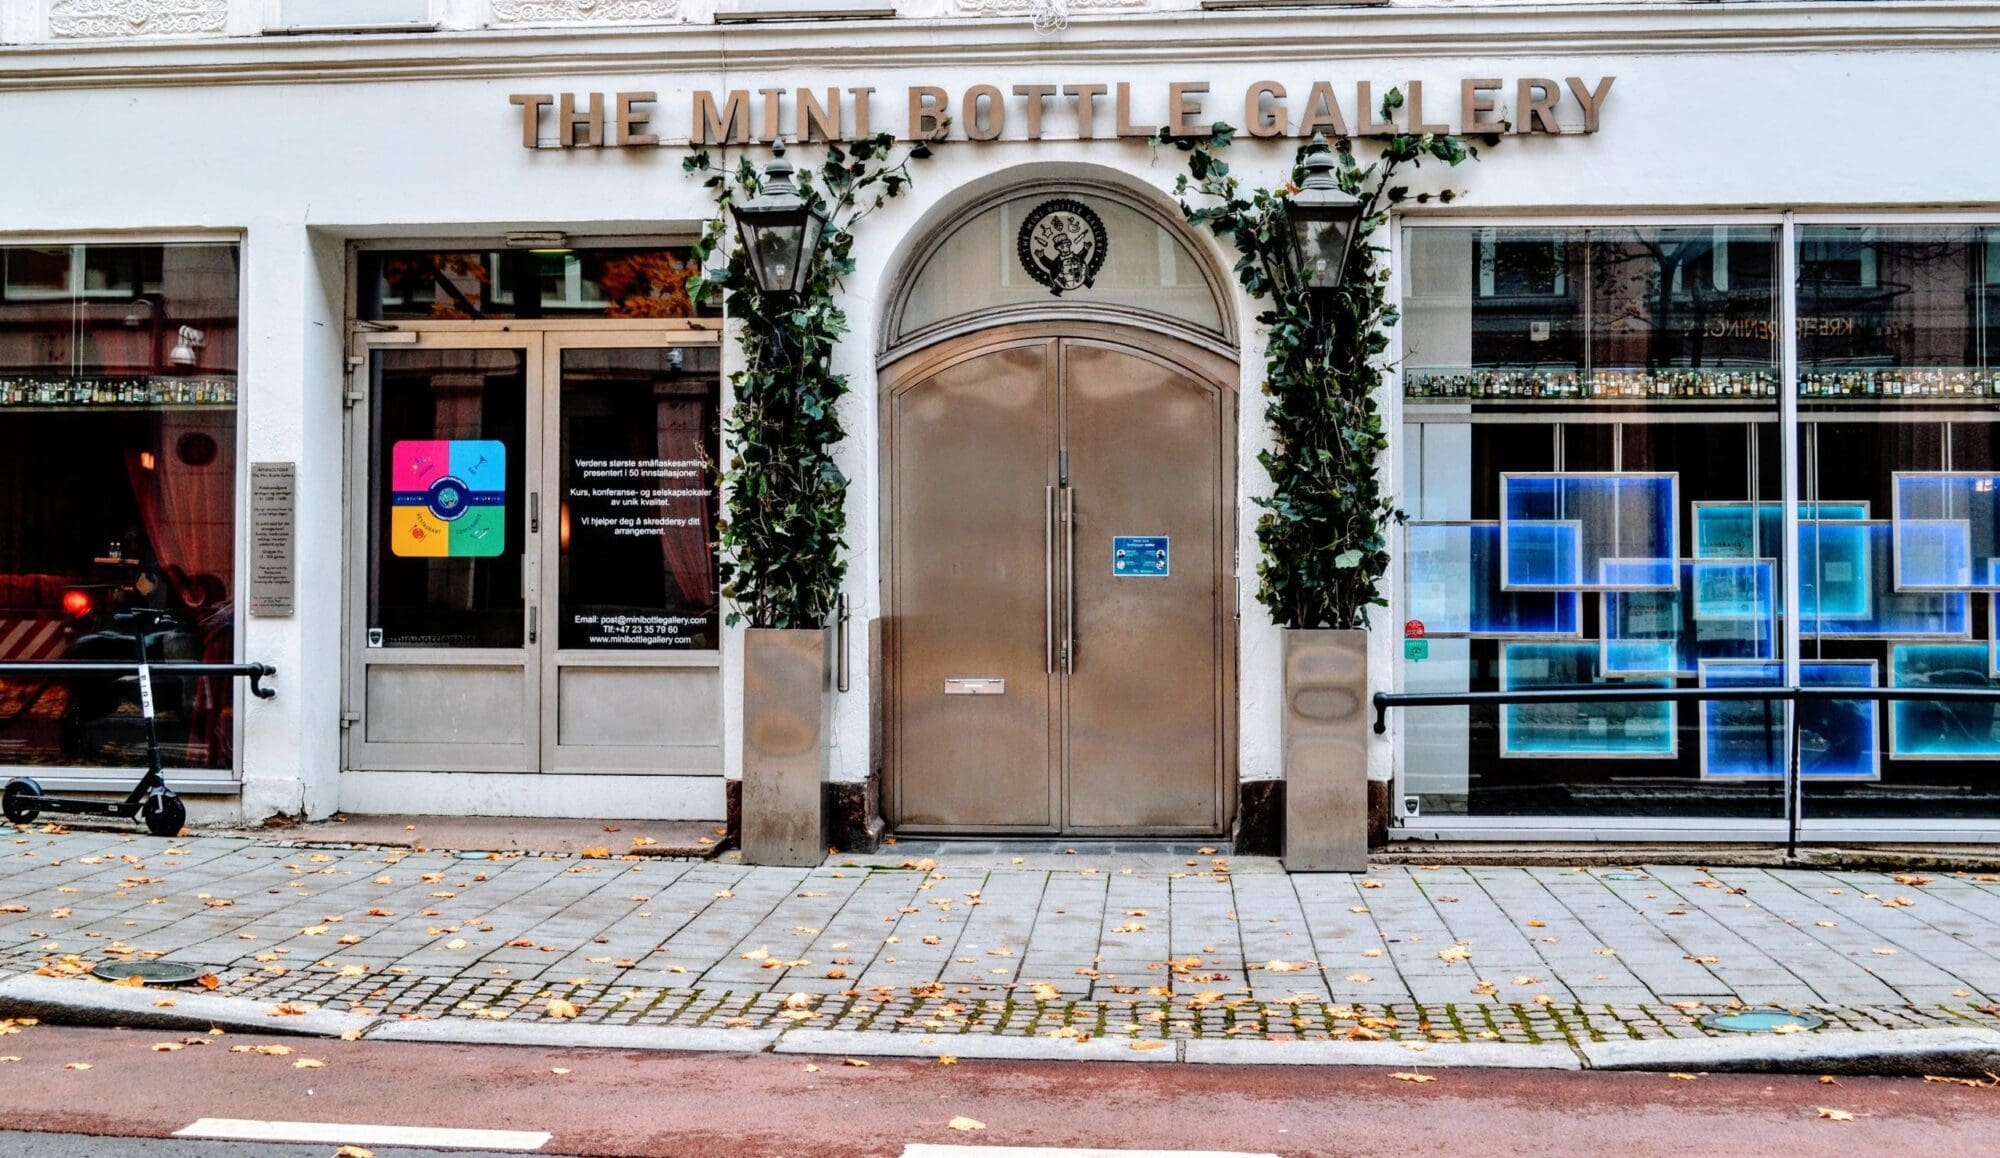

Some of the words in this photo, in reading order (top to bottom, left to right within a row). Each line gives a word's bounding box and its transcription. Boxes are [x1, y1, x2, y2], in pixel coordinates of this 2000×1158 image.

[509, 91, 660, 149] THE
[692, 86, 876, 146] MINI
[908, 81, 1211, 142] BOTTLE
[1244, 76, 1617, 138] GALLERY
[575, 459, 607, 467] Verdens
[609, 459, 636, 467] største
[638, 459, 707, 469] småflaskesamling
[583, 469, 622, 478] presentert
[628, 469, 639, 477] 50
[570, 488, 590, 497] Kurs,
[592, 488, 638, 496] konferanse-
[640, 490, 650, 498] og
[652, 488, 712, 498] selskapslokaler
[622, 498, 639, 506] unik
[640, 498, 670, 506] kvalitet.
[581, 517, 590, 525] Vi
[591, 517, 618, 527] hjelper
[619, 517, 634, 527] deg
[635, 516, 642, 525] å
[643, 517, 686, 527] skreddersy
[687, 517, 700, 525] ditt
[614, 528, 666, 537] arrangement.
[575, 615, 599, 624] Email:
[600, 615, 707, 626] post@minibottlegallery.com
[632, 625, 642, 633] 23
[643, 625, 654, 633] 35
[656, 625, 666, 633] 79
[667, 625, 679, 633] 60
